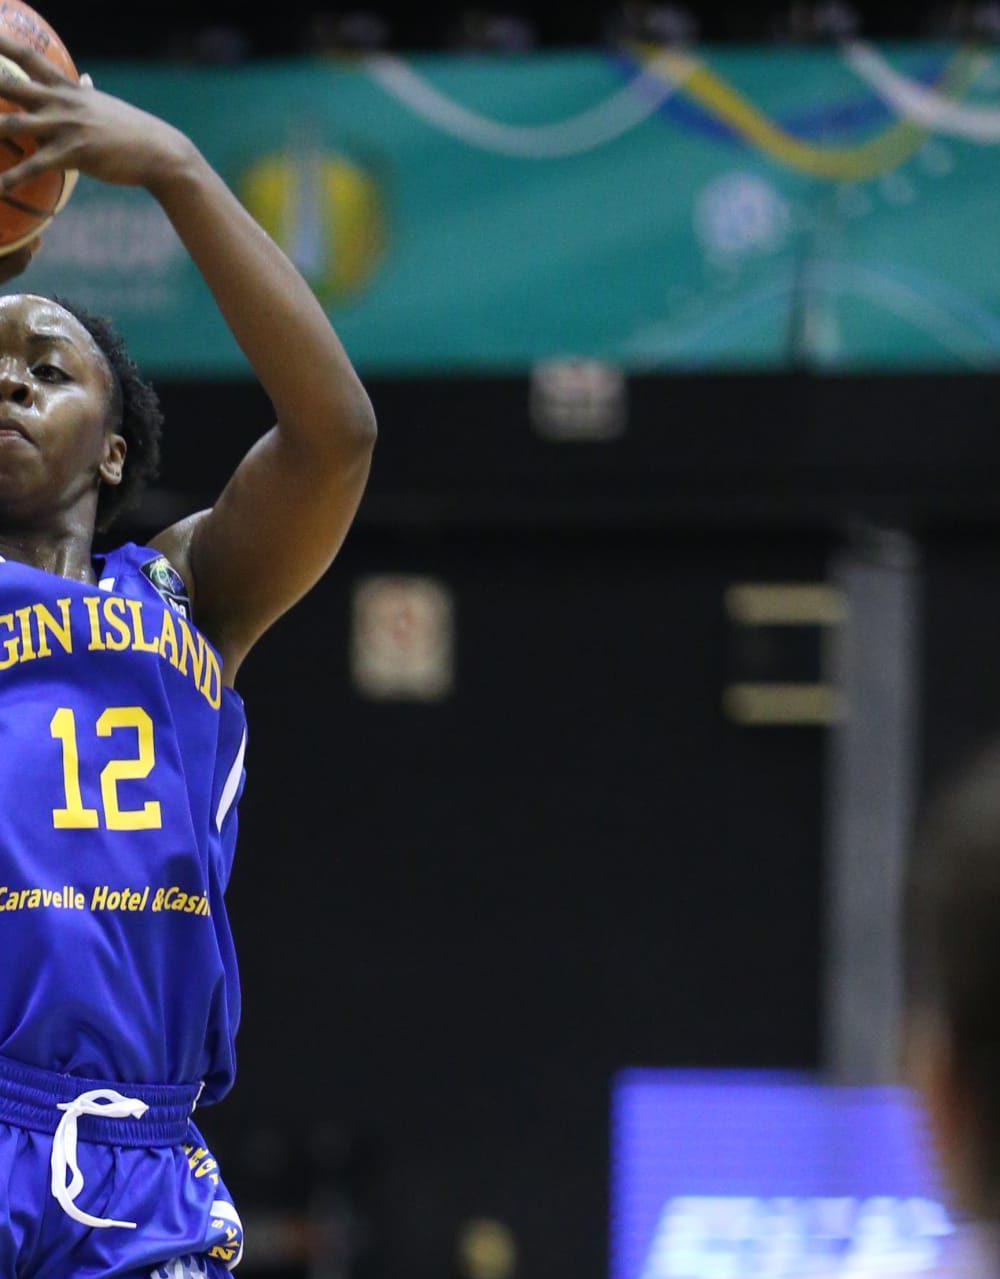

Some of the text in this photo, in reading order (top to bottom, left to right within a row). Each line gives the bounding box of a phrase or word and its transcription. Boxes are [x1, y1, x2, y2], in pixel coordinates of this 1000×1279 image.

[83, 597, 222, 710] ISLAND
[50, 707, 162, 831] 12
[91, 886, 150, 912] Hotel
